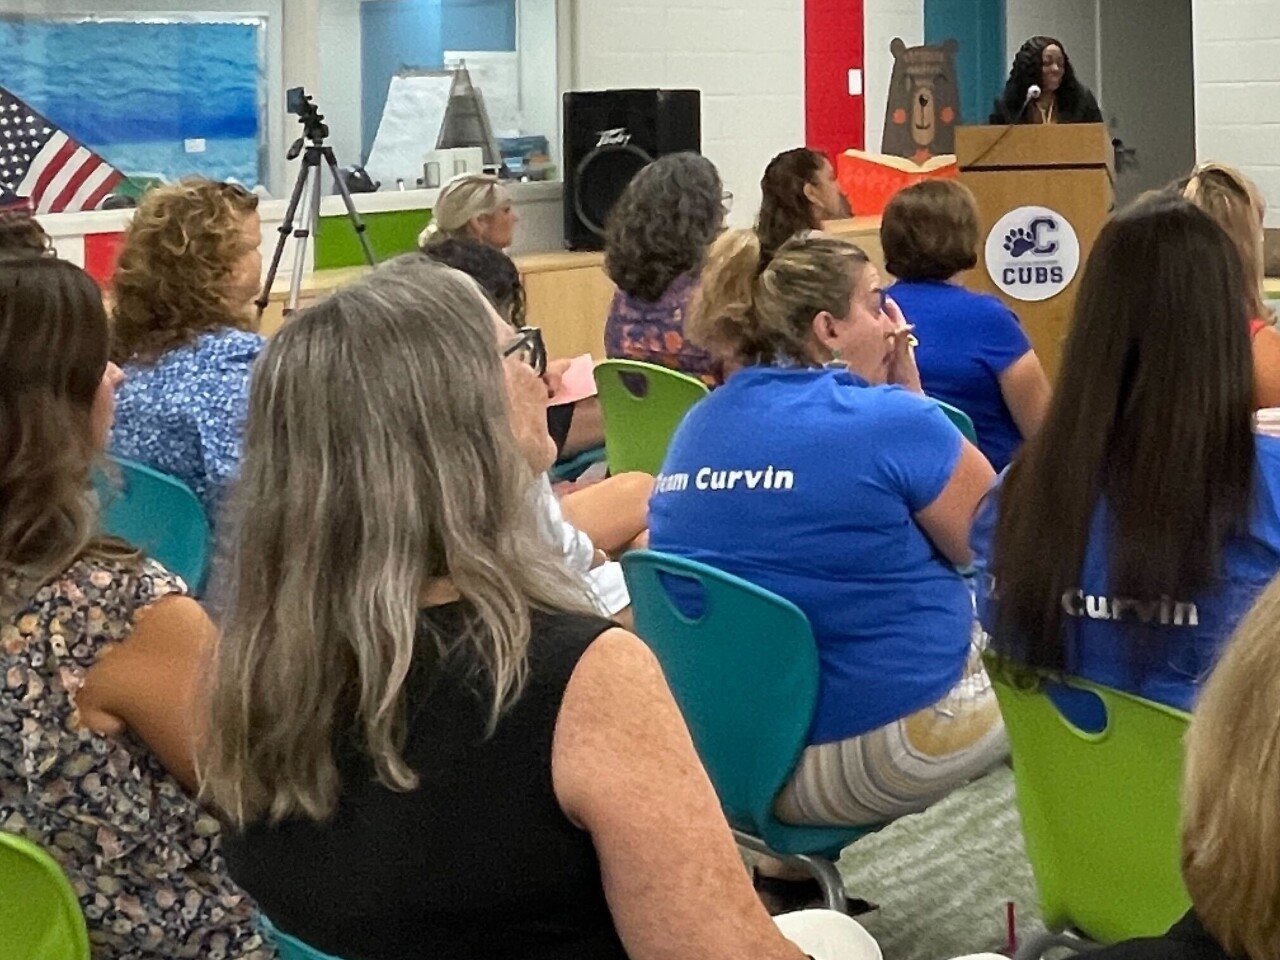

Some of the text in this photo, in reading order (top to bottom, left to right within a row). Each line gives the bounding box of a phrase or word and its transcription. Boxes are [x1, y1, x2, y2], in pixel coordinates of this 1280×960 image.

[1028, 216, 1059, 257] C
[1003, 266, 1063, 285] CUBS
[696, 465, 794, 490] Curvin
[1061, 589, 1199, 626] Curin
